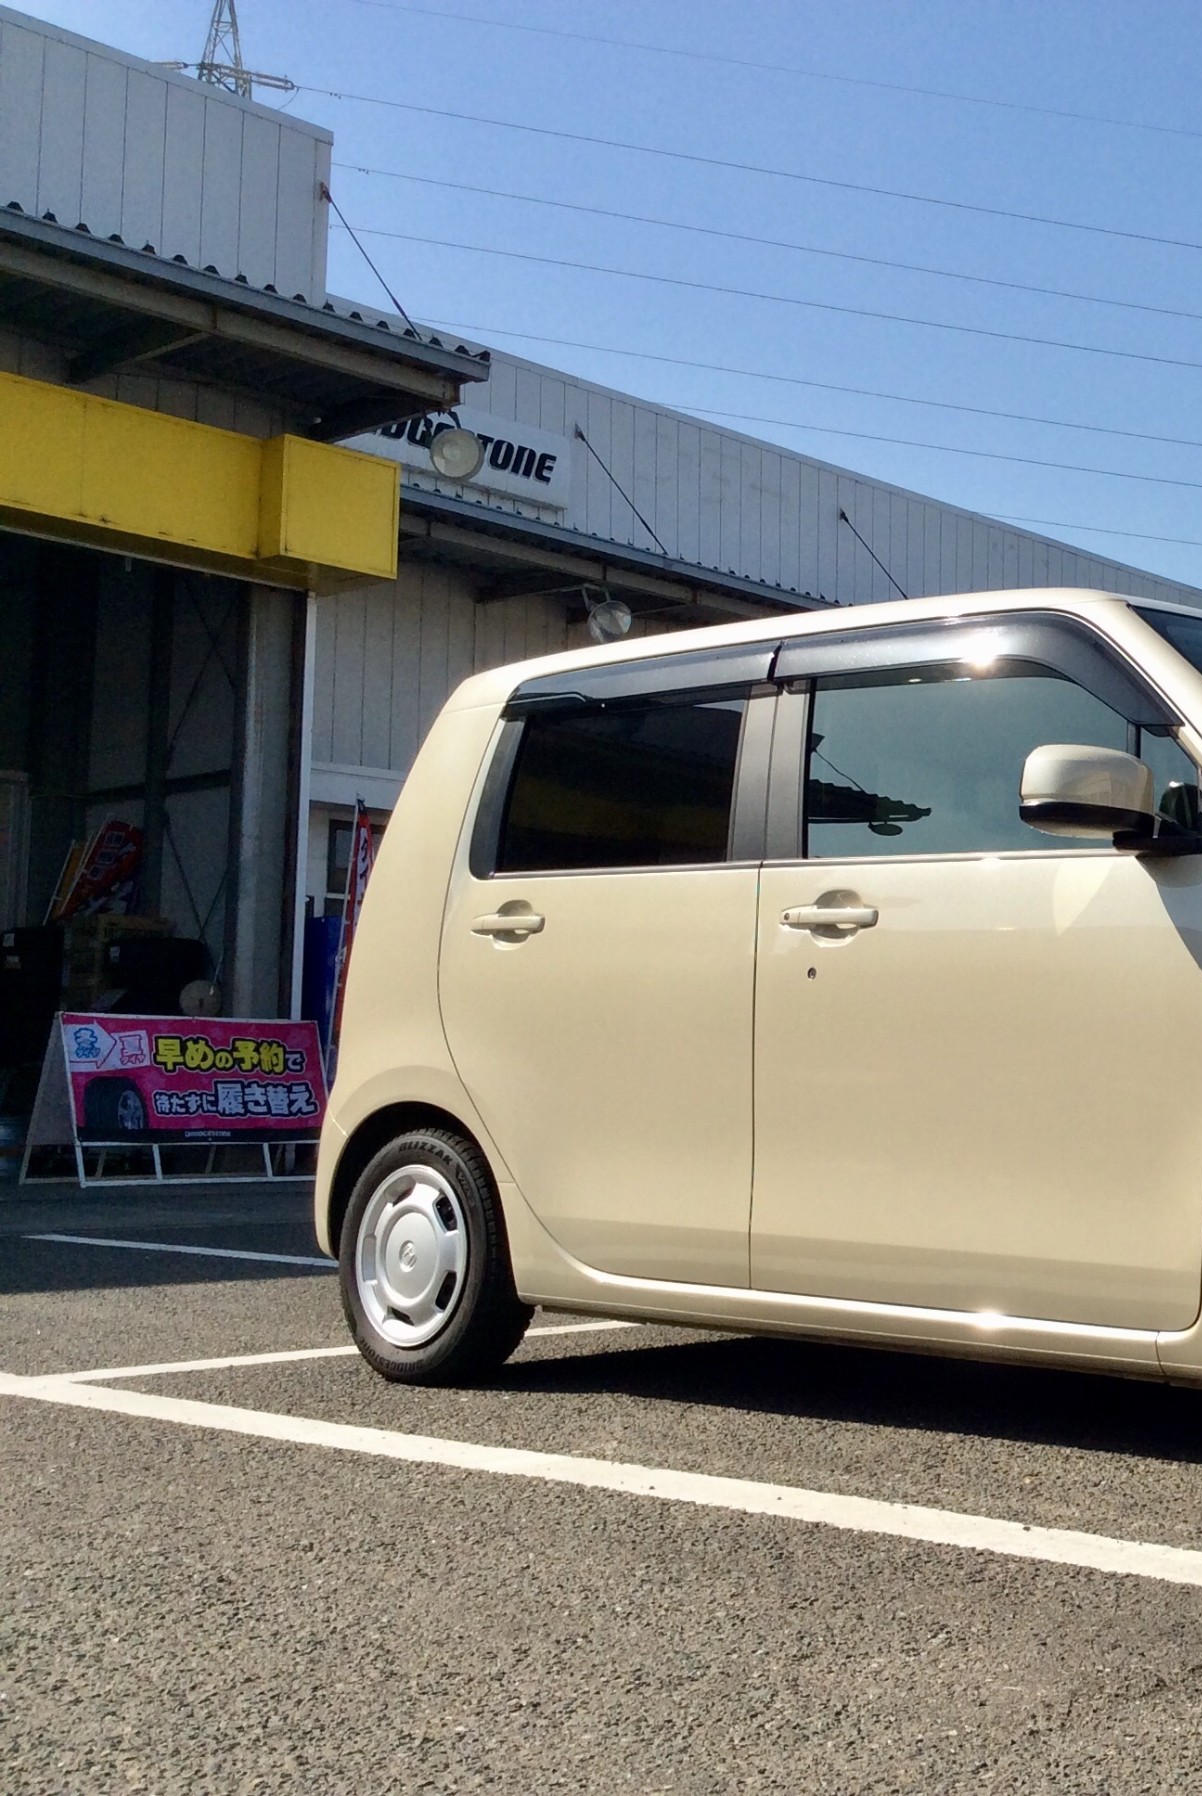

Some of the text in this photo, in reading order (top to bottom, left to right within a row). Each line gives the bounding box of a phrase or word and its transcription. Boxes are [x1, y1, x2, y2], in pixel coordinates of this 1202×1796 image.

[153, 1035, 305, 1073] 早めの予約で
[155, 1080, 318, 1116] 待たずに履き替え
[398, 1140, 454, 1165] BLIZZAK
